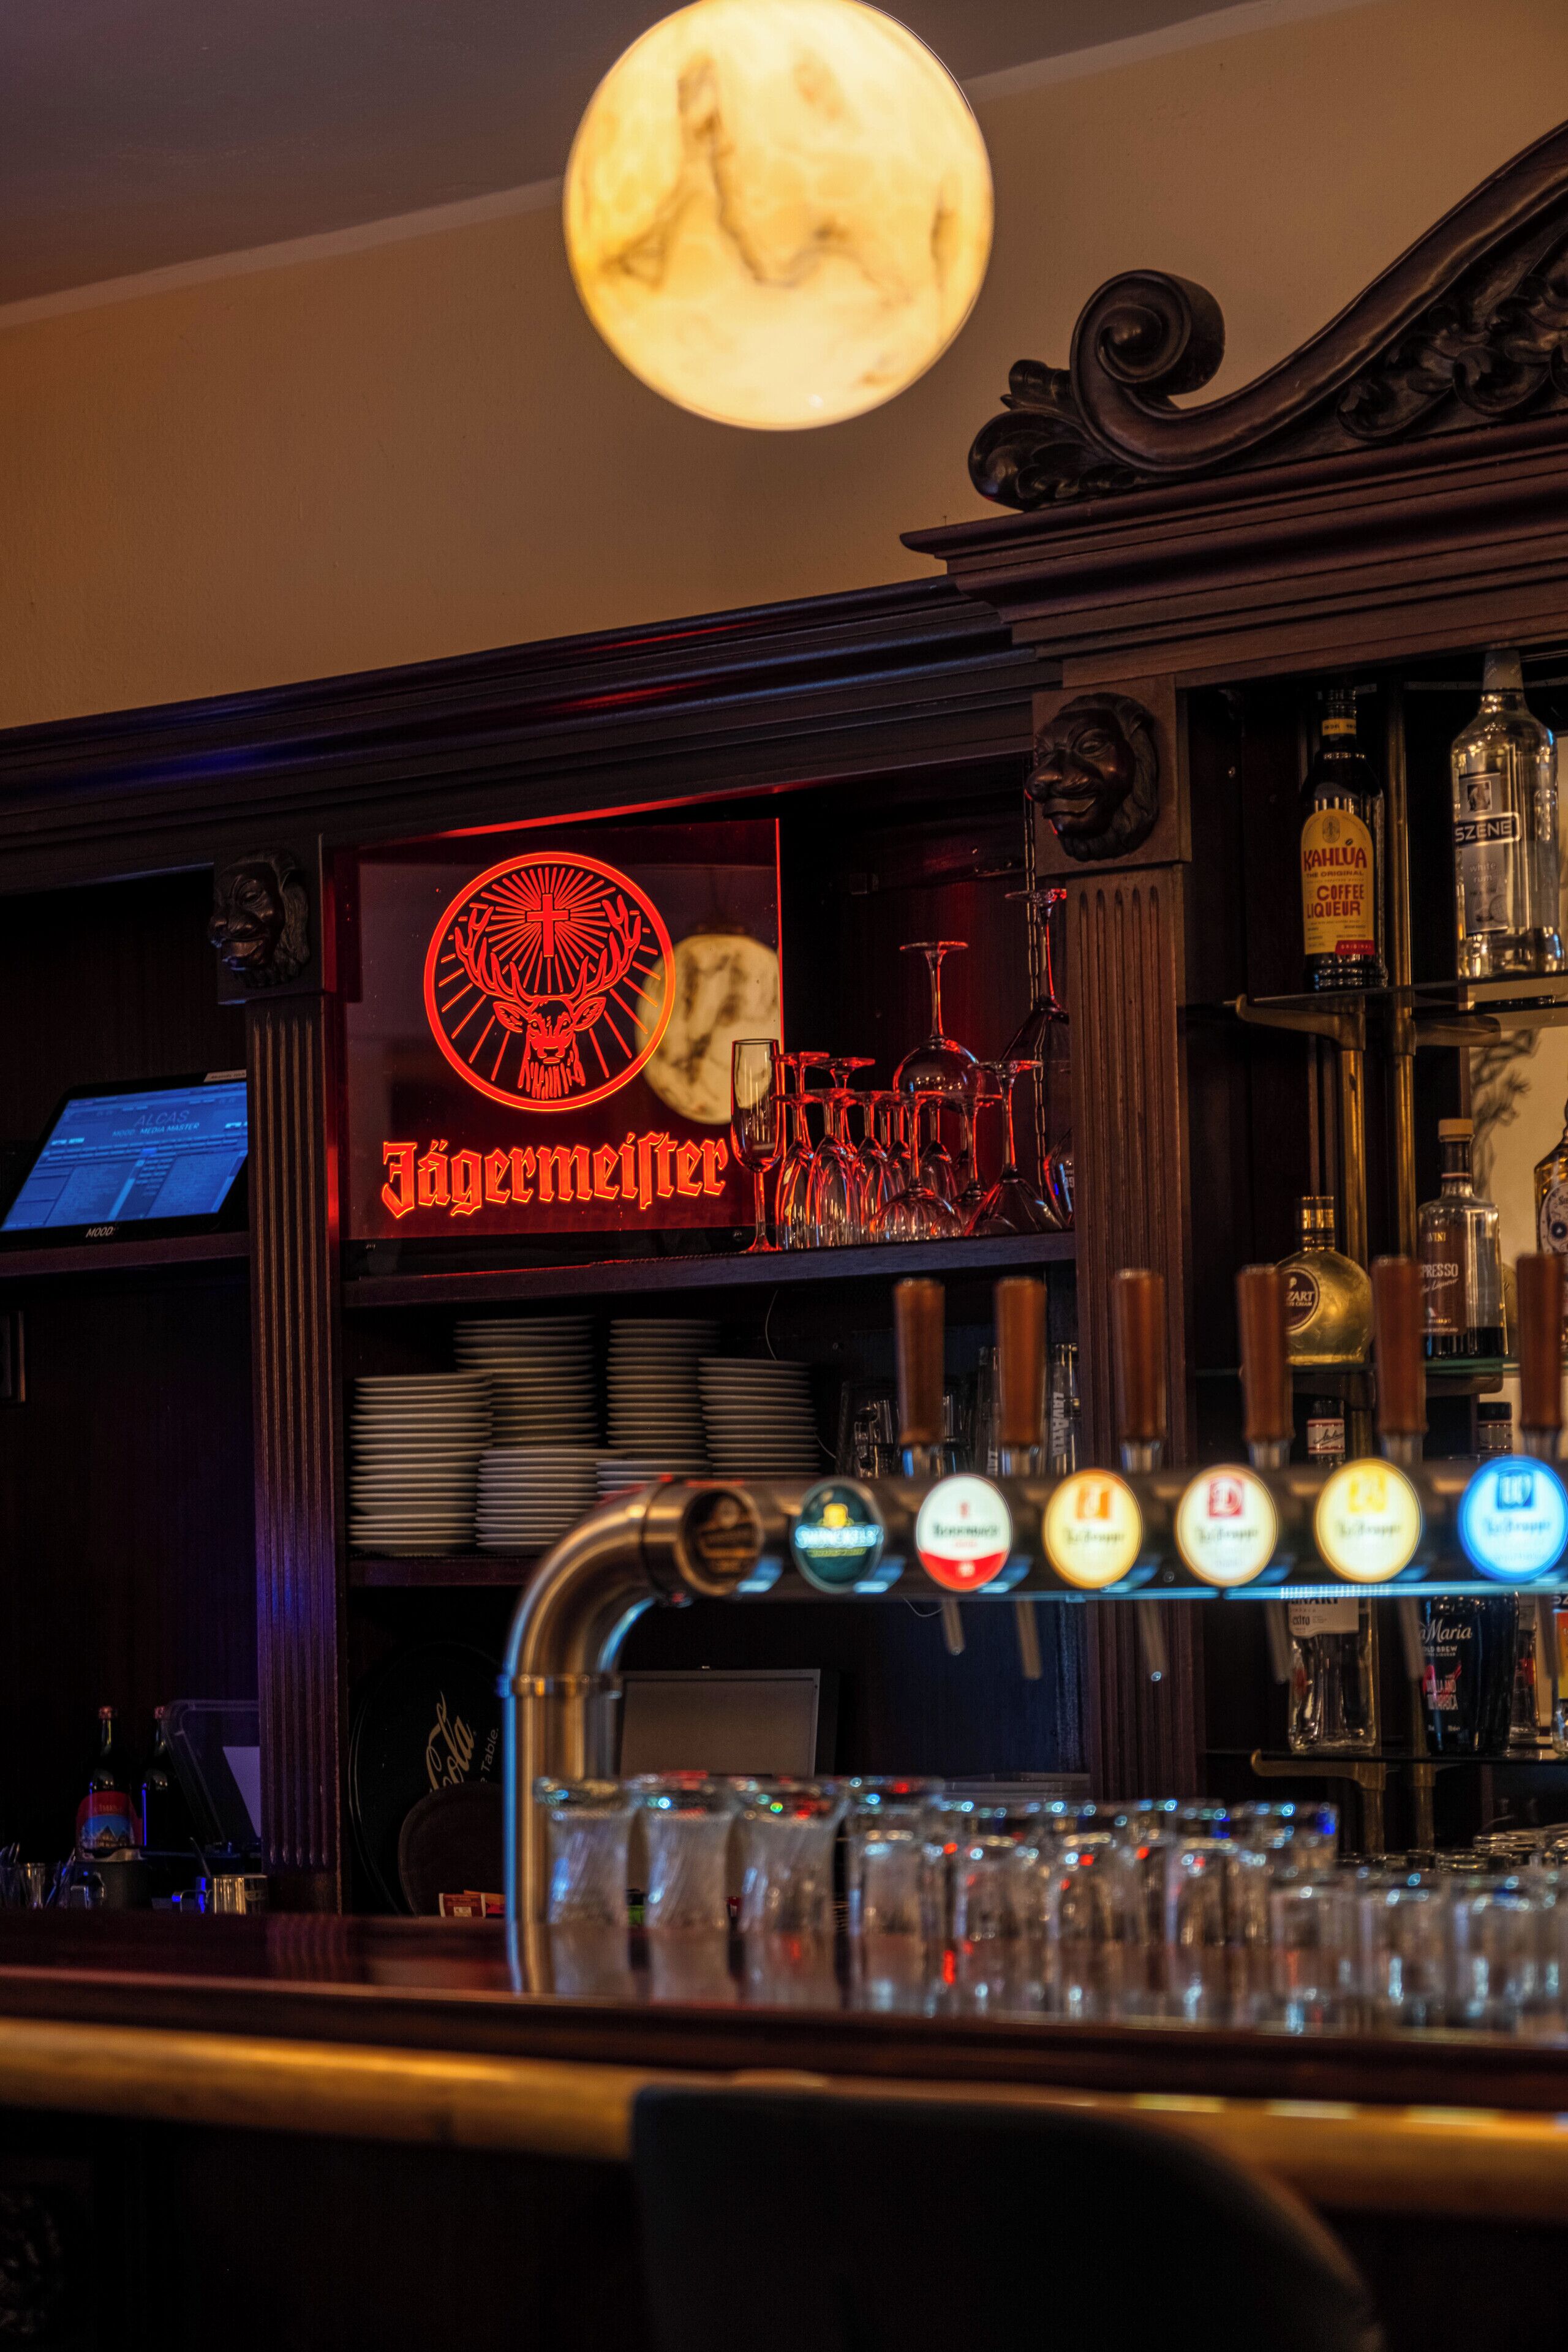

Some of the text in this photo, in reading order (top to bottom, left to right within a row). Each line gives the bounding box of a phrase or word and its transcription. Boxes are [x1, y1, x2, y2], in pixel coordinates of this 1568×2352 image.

[1455, 820, 1511, 842] SZENE
[1317, 884, 1365, 901] COFFEE
[1306, 900, 1361, 918] LIQUEUR
[1420, 1263, 1459, 1278] PRESSO
[1287, 1291, 1314, 1302] ZART
[1053, 1391, 1069, 1457] LAVAZZA
[1425, 1619, 1472, 1644] Maria
